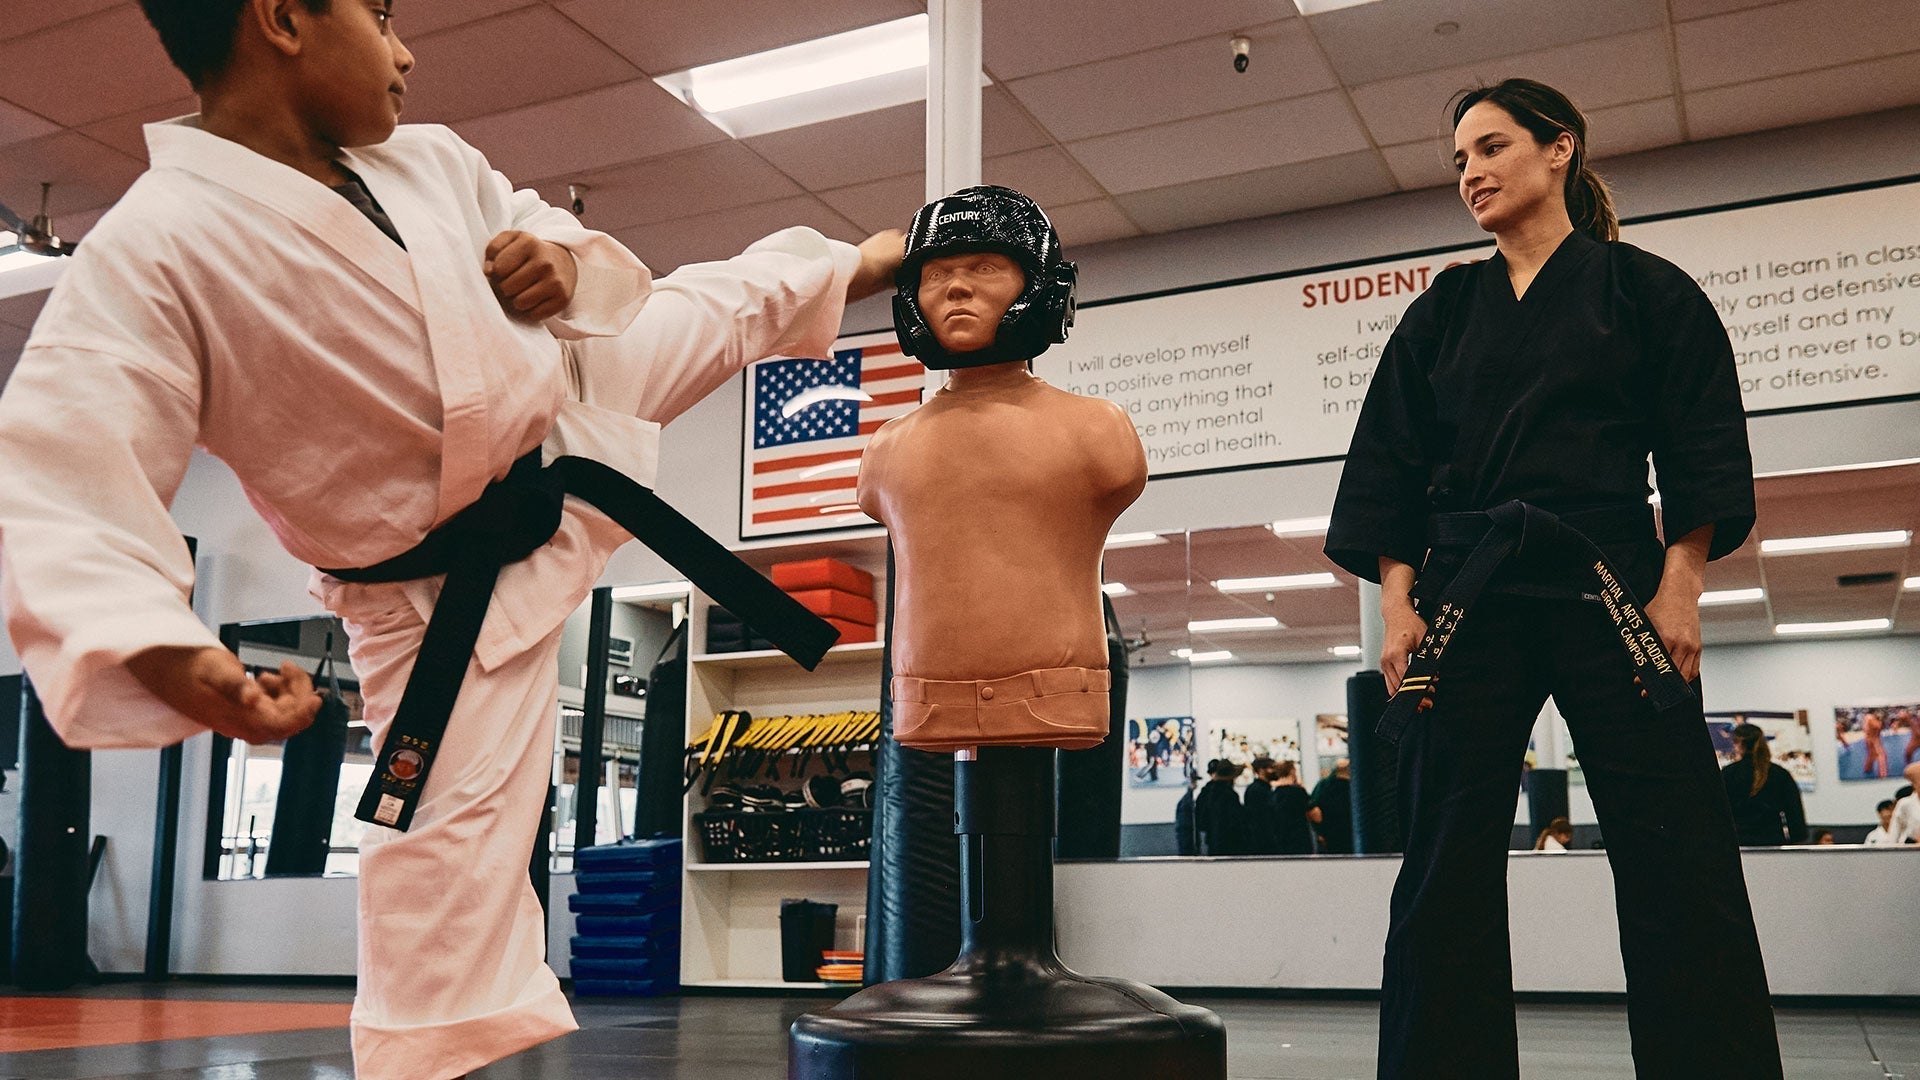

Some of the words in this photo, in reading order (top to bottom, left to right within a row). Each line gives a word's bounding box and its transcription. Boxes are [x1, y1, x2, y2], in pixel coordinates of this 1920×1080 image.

[939, 211, 980, 225] CENTURY
[1768, 254, 1830, 279] learn
[1837, 252, 1858, 269] in
[1302, 266, 1431, 309] STUDENT
[1746, 286, 1795, 309] and
[1802, 272, 1920, 304] defensive
[1367, 314, 1397, 332] will
[1798, 308, 1848, 331] and
[1856, 306, 1894, 324] my
[1078, 355, 1104, 372] will
[1109, 347, 1186, 370] develop
[1192, 335, 1251, 358] myself
[1735, 344, 1780, 366] and
[1788, 338, 1857, 359] never
[1866, 332, 1892, 350] to
[1899, 328, 1920, 346] b
[1087, 384, 1099, 396] a
[1105, 373, 1173, 397] positive
[1179, 361, 1252, 384] manner
[1323, 373, 1342, 389] to
[1741, 378, 1762, 393] or
[1770, 363, 1889, 390] offensive.
[1148, 389, 1228, 414] anything
[1235, 383, 1273, 401] that
[1323, 398, 1339, 414] in
[1163, 419, 1190, 435] my
[1197, 408, 1263, 430] mental
[1148, 439, 1210, 463] hysical
[1216, 431, 1282, 452] health.
[1593, 561, 1624, 602] MARTIAL
[1621, 603, 1643, 629] ARTS
[1637, 631, 1673, 675] ACADEMY
[1600, 589, 1623, 626] BRIANA
[1620, 627, 1648, 667] CAMPOS
